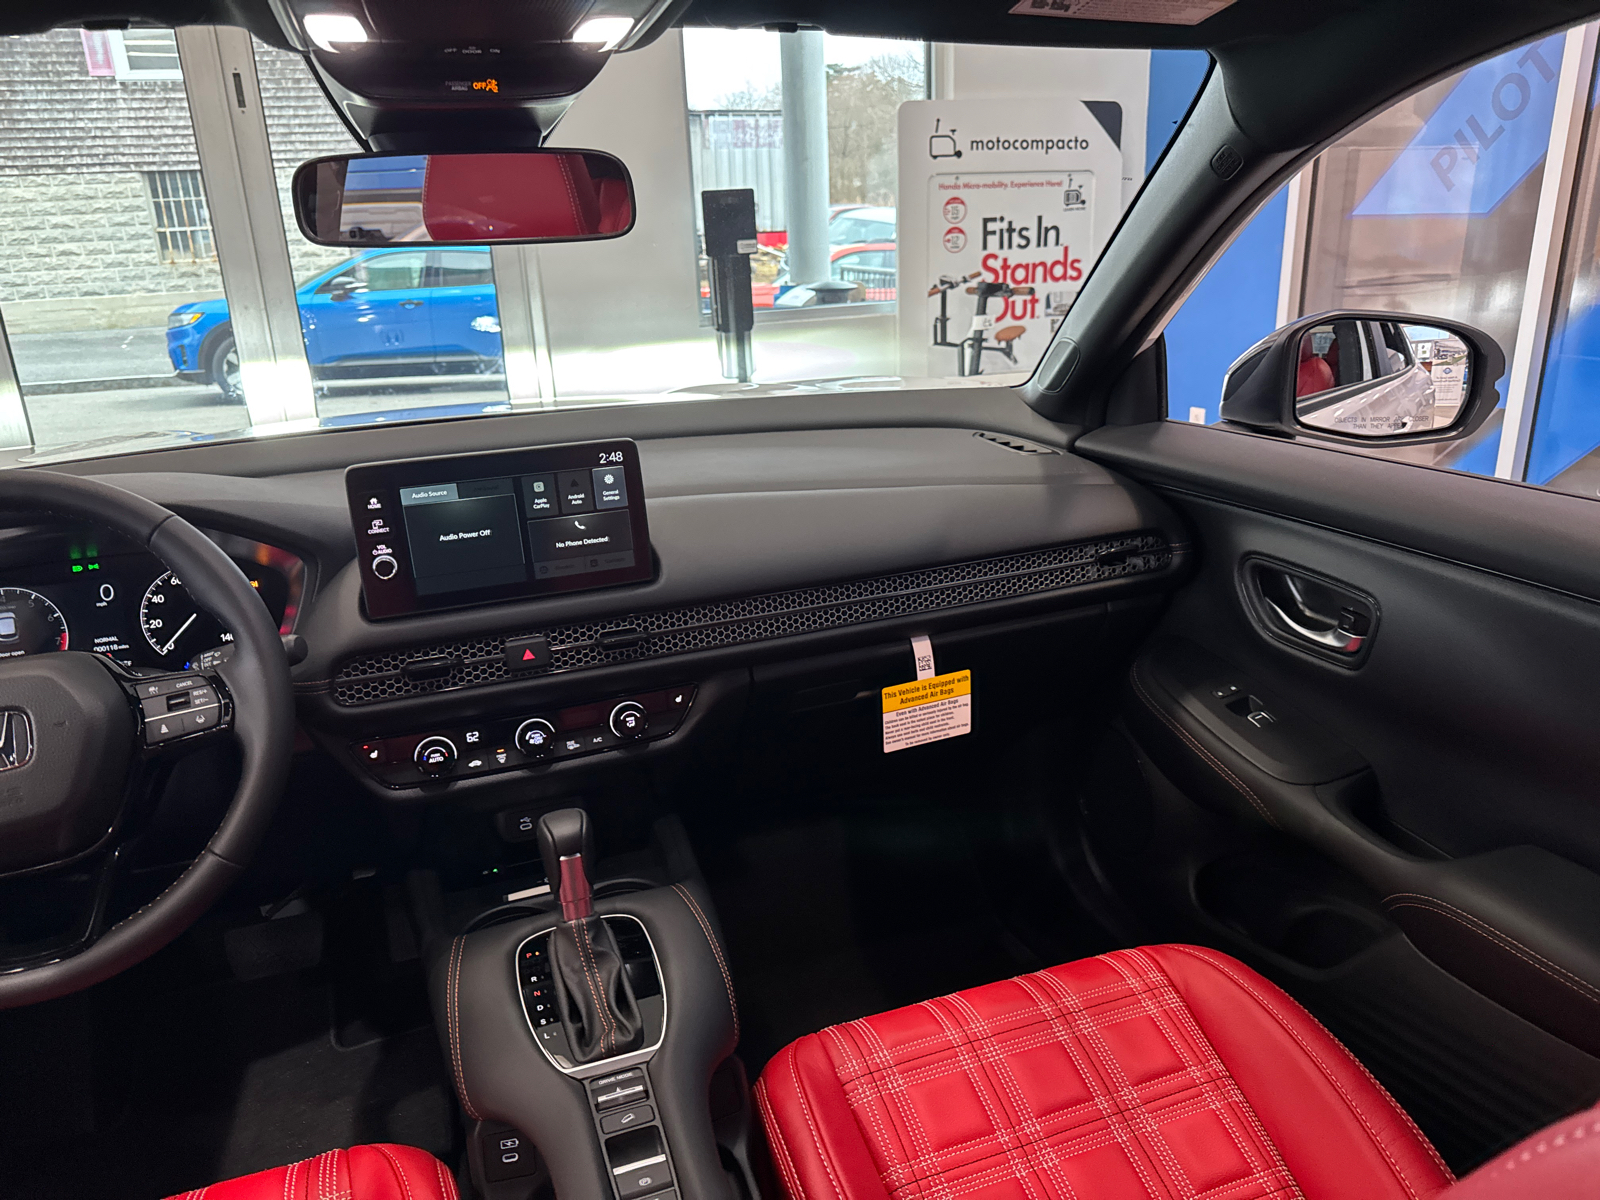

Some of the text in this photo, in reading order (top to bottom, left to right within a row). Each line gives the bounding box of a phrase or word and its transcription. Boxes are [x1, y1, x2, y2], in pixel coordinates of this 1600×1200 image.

[472, 81, 487, 90] OFF
[1430, 42, 1556, 192] PILOT
[970, 136, 1089, 155] motocompacto
[938, 182, 961, 190] Honda
[1010, 180, 1044, 189] Experience
[981, 215, 1060, 252] Fits In
[981, 246, 1083, 286] Stands
[598, 451, 624, 464] 2:48
[428, 490, 448, 498] Source
[367, 527, 390, 535] CONNECT
[439, 529, 492, 542] Audio Power Off
[555, 536, 609, 549] No Phone Detected
[100, 584, 115, 601] 0
[28, 600, 35, 608] 5
[151, 594, 164, 604] 40
[47, 614, 54, 622] 6
[149, 619, 163, 629] 20
[54, 636, 61, 645] 7
[94, 635, 119, 644] NORMAL
[175, 680, 193, 688] CANCEL
[884, 675, 969, 700] This Vehicle is Equipped with
[900, 687, 954, 704] Advanced Air Bags
[896, 710, 907, 718] Even
[907, 707, 918, 715] with
[918, 702, 940, 712] Advanced
[948, 698, 959, 706] Bags
[465, 731, 480, 743] 62
[598, 1072, 633, 1085] DRIVE MODE
